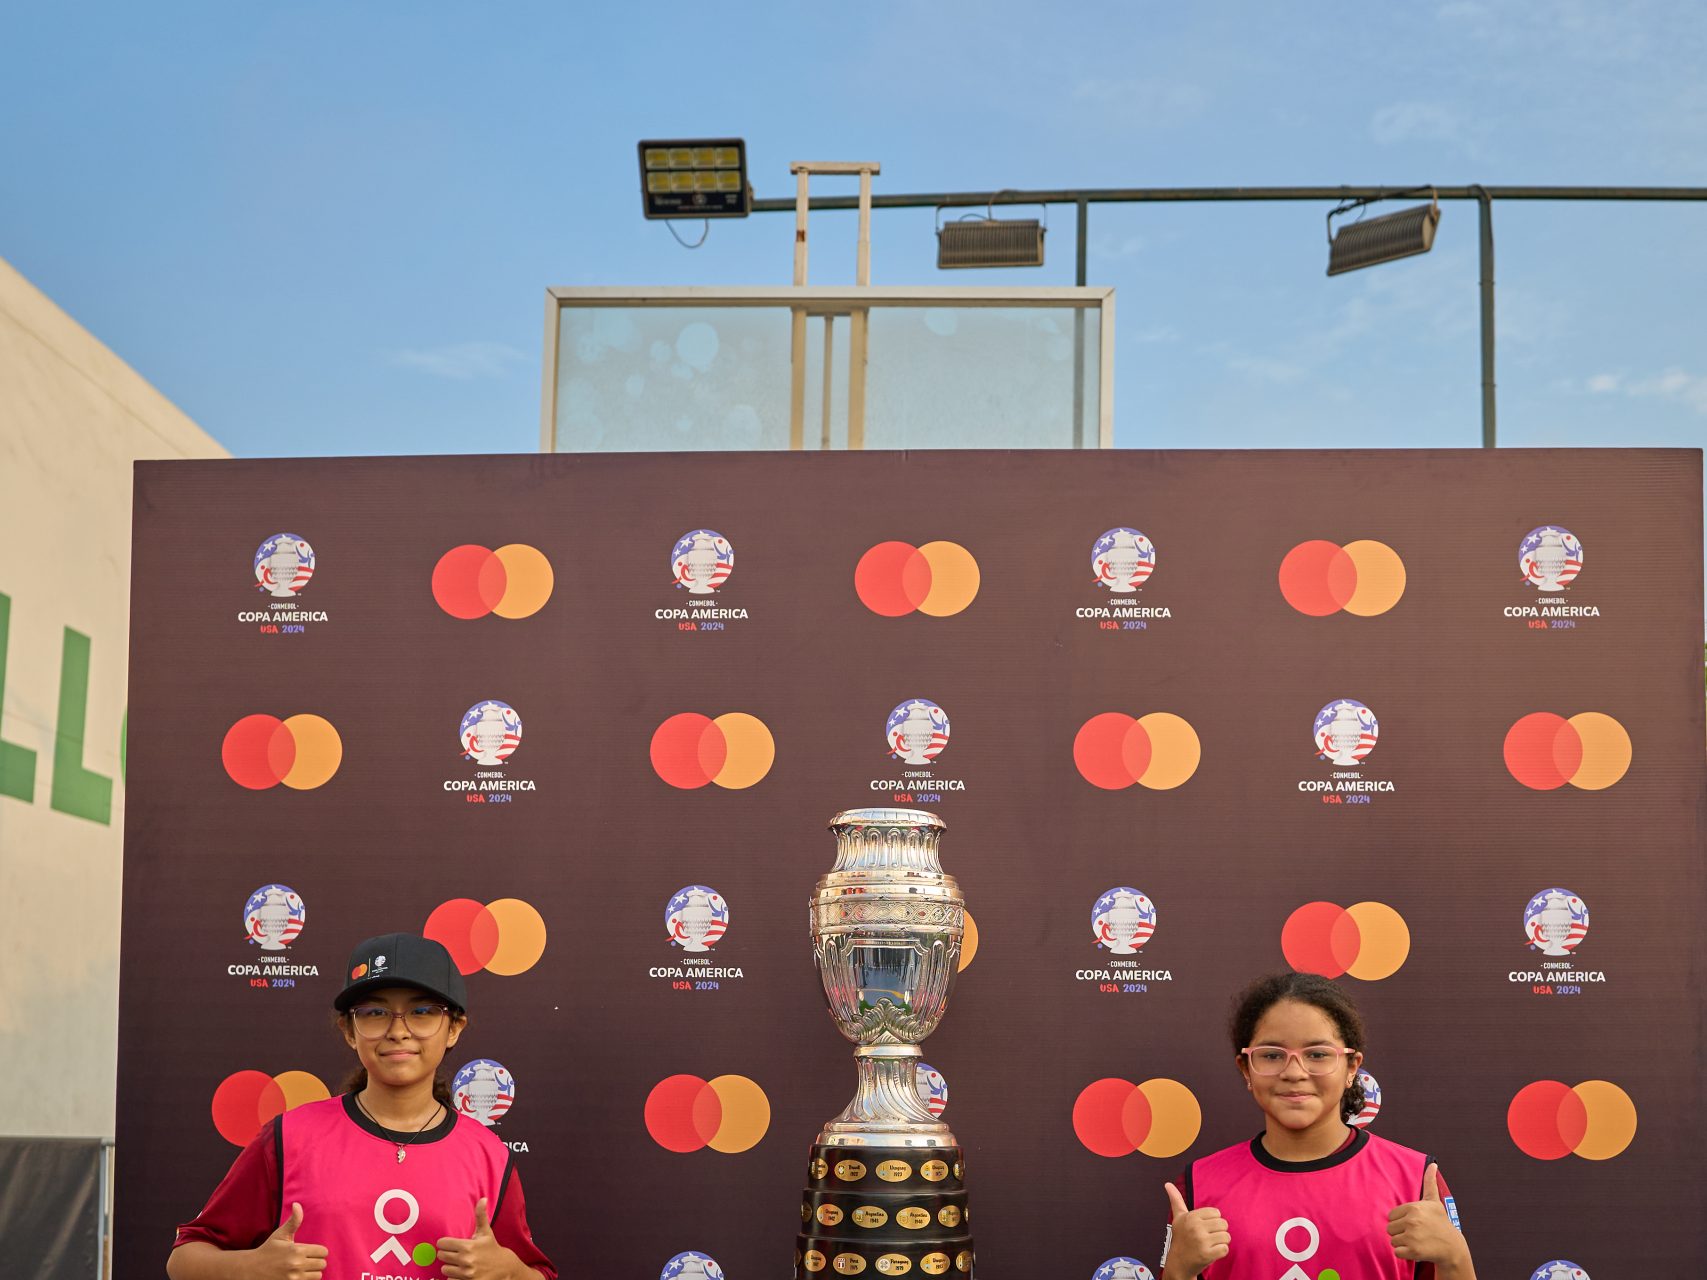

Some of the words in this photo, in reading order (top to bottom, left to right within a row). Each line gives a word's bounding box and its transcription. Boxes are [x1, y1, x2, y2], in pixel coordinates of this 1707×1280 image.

[237, 612, 270, 622] COPA
[272, 612, 328, 622] AMERICA
[654, 609, 688, 620] COPA
[690, 609, 748, 619] AMERICA
[1075, 608, 1110, 618] COPA
[1112, 608, 1171, 618] AMERICA
[1503, 607, 1538, 618] COPA
[1540, 607, 1600, 617] AMERICA
[259, 625, 278, 634] USA
[281, 625, 304, 634] 2024
[677, 622, 697, 632] USA
[700, 622, 724, 631] 2024
[1099, 621, 1119, 630] USA
[1122, 621, 1146, 630] 2024
[1527, 620, 1547, 630] USA
[1550, 620, 1575, 629] 2024
[443, 781, 477, 791] COPA
[478, 781, 535, 791] AMERICA
[870, 780, 904, 791] COPA
[906, 780, 965, 791] AMERICA
[1298, 781, 1333, 792] COPA
[1335, 781, 1394, 792] AMERICA
[466, 794, 485, 804] USA
[488, 794, 511, 803] 2024
[893, 793, 913, 803] USA
[916, 794, 940, 803] 2024
[1322, 795, 1342, 804] USA
[1345, 795, 1370, 804] 2024
[227, 965, 260, 976] COPA
[262, 965, 318, 976] AMERICA
[649, 968, 683, 978] COPA
[685, 968, 743, 978] AMERICA
[1075, 970, 1110, 981] COPA
[1112, 970, 1172, 981] AMERICA
[1508, 972, 1544, 983] COPA
[1545, 972, 1605, 983] AMERICA
[249, 979, 268, 988] USA
[271, 979, 295, 988] 2024
[672, 981, 691, 991] USA
[695, 981, 719, 991] 2024
[1099, 984, 1119, 993] USA
[1122, 984, 1147, 993] 2024
[1532, 986, 1552, 995] USA
[1556, 986, 1580, 995] 2024
